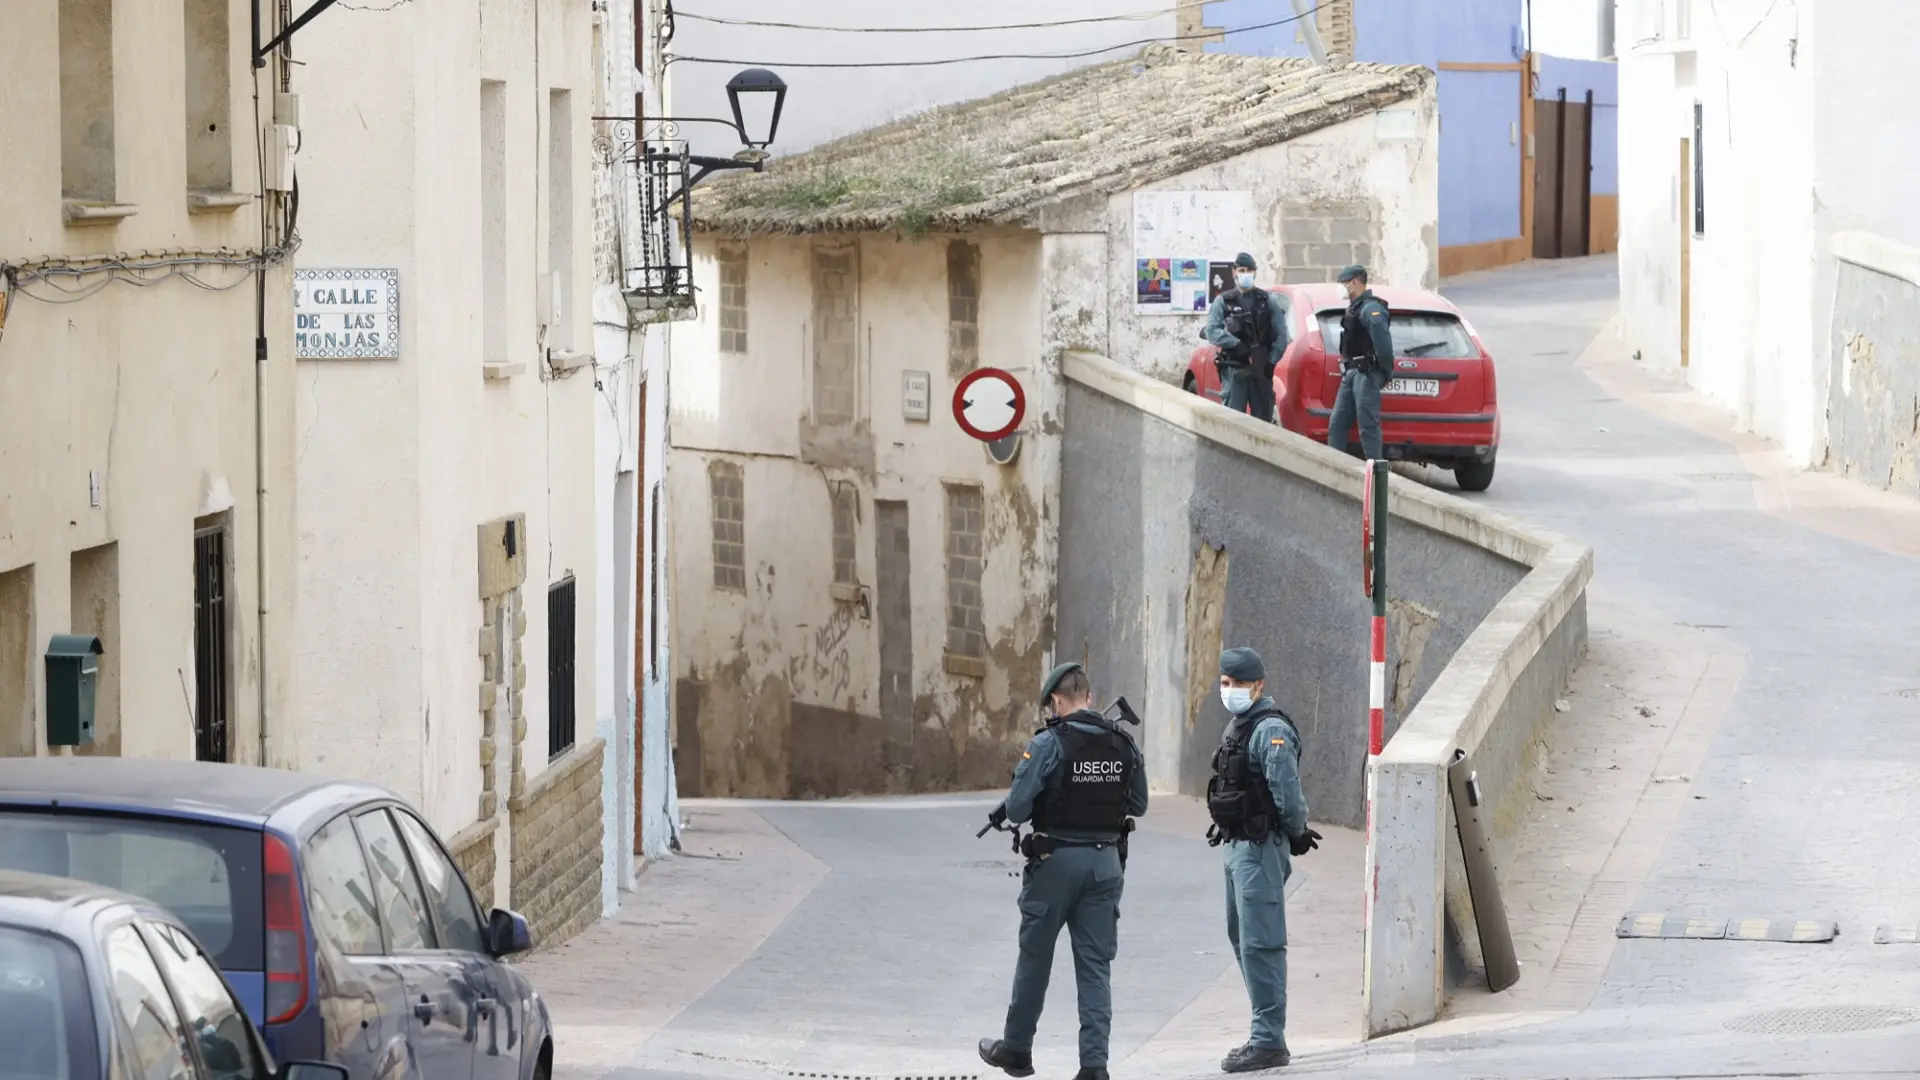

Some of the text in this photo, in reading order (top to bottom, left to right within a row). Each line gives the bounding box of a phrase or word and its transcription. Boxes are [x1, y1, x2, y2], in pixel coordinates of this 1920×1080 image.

[313, 288, 378, 304] CALLE
[296, 313, 376, 330] DE LAS
[295, 332, 380, 348] MONJAS
[1415, 381, 1437, 392] DXZ
[1073, 761, 1123, 774] USECIC
[1072, 775, 1122, 783] GUARDIA CIVIL
